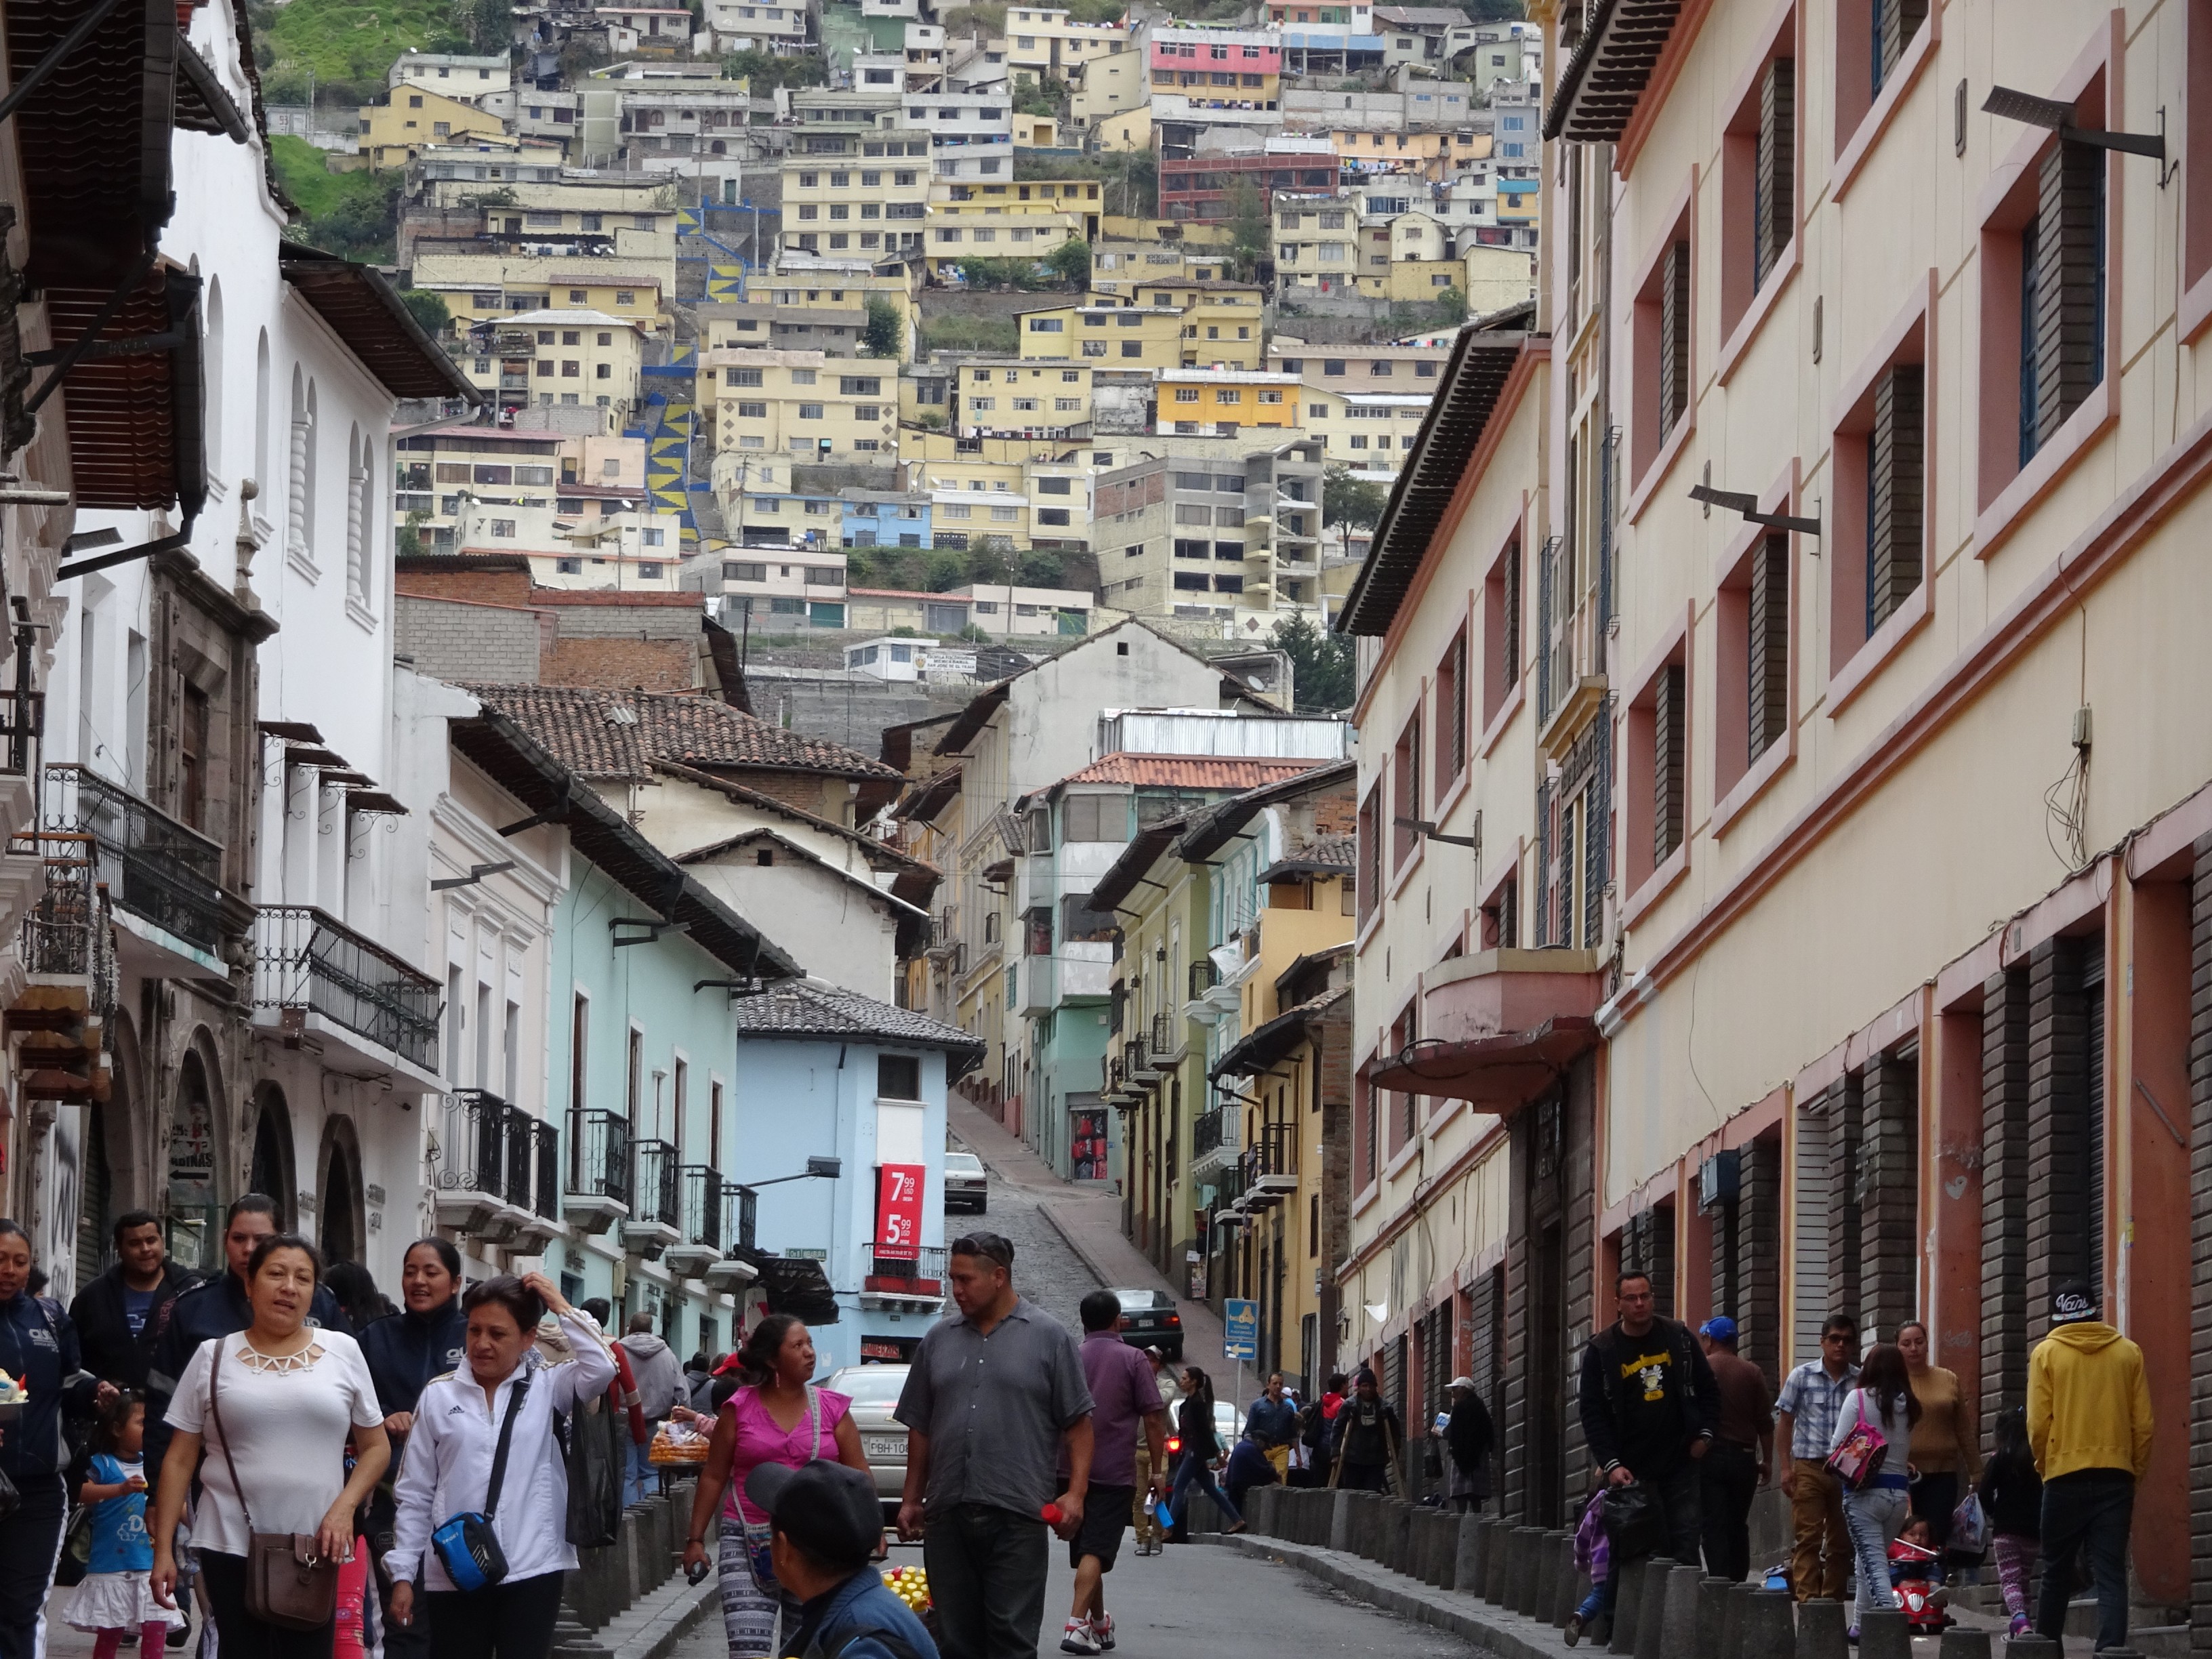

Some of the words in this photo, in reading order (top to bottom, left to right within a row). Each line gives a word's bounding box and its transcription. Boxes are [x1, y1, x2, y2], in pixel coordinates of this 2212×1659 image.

[891, 1172, 905, 1202] 7
[904, 1177, 915, 1188] 99
[886, 1214, 901, 1244] 5
[901, 1218, 912, 1230] 99
[2055, 1293, 2089, 1313] Vans
[441, 1532, 459, 1544] SPORT
